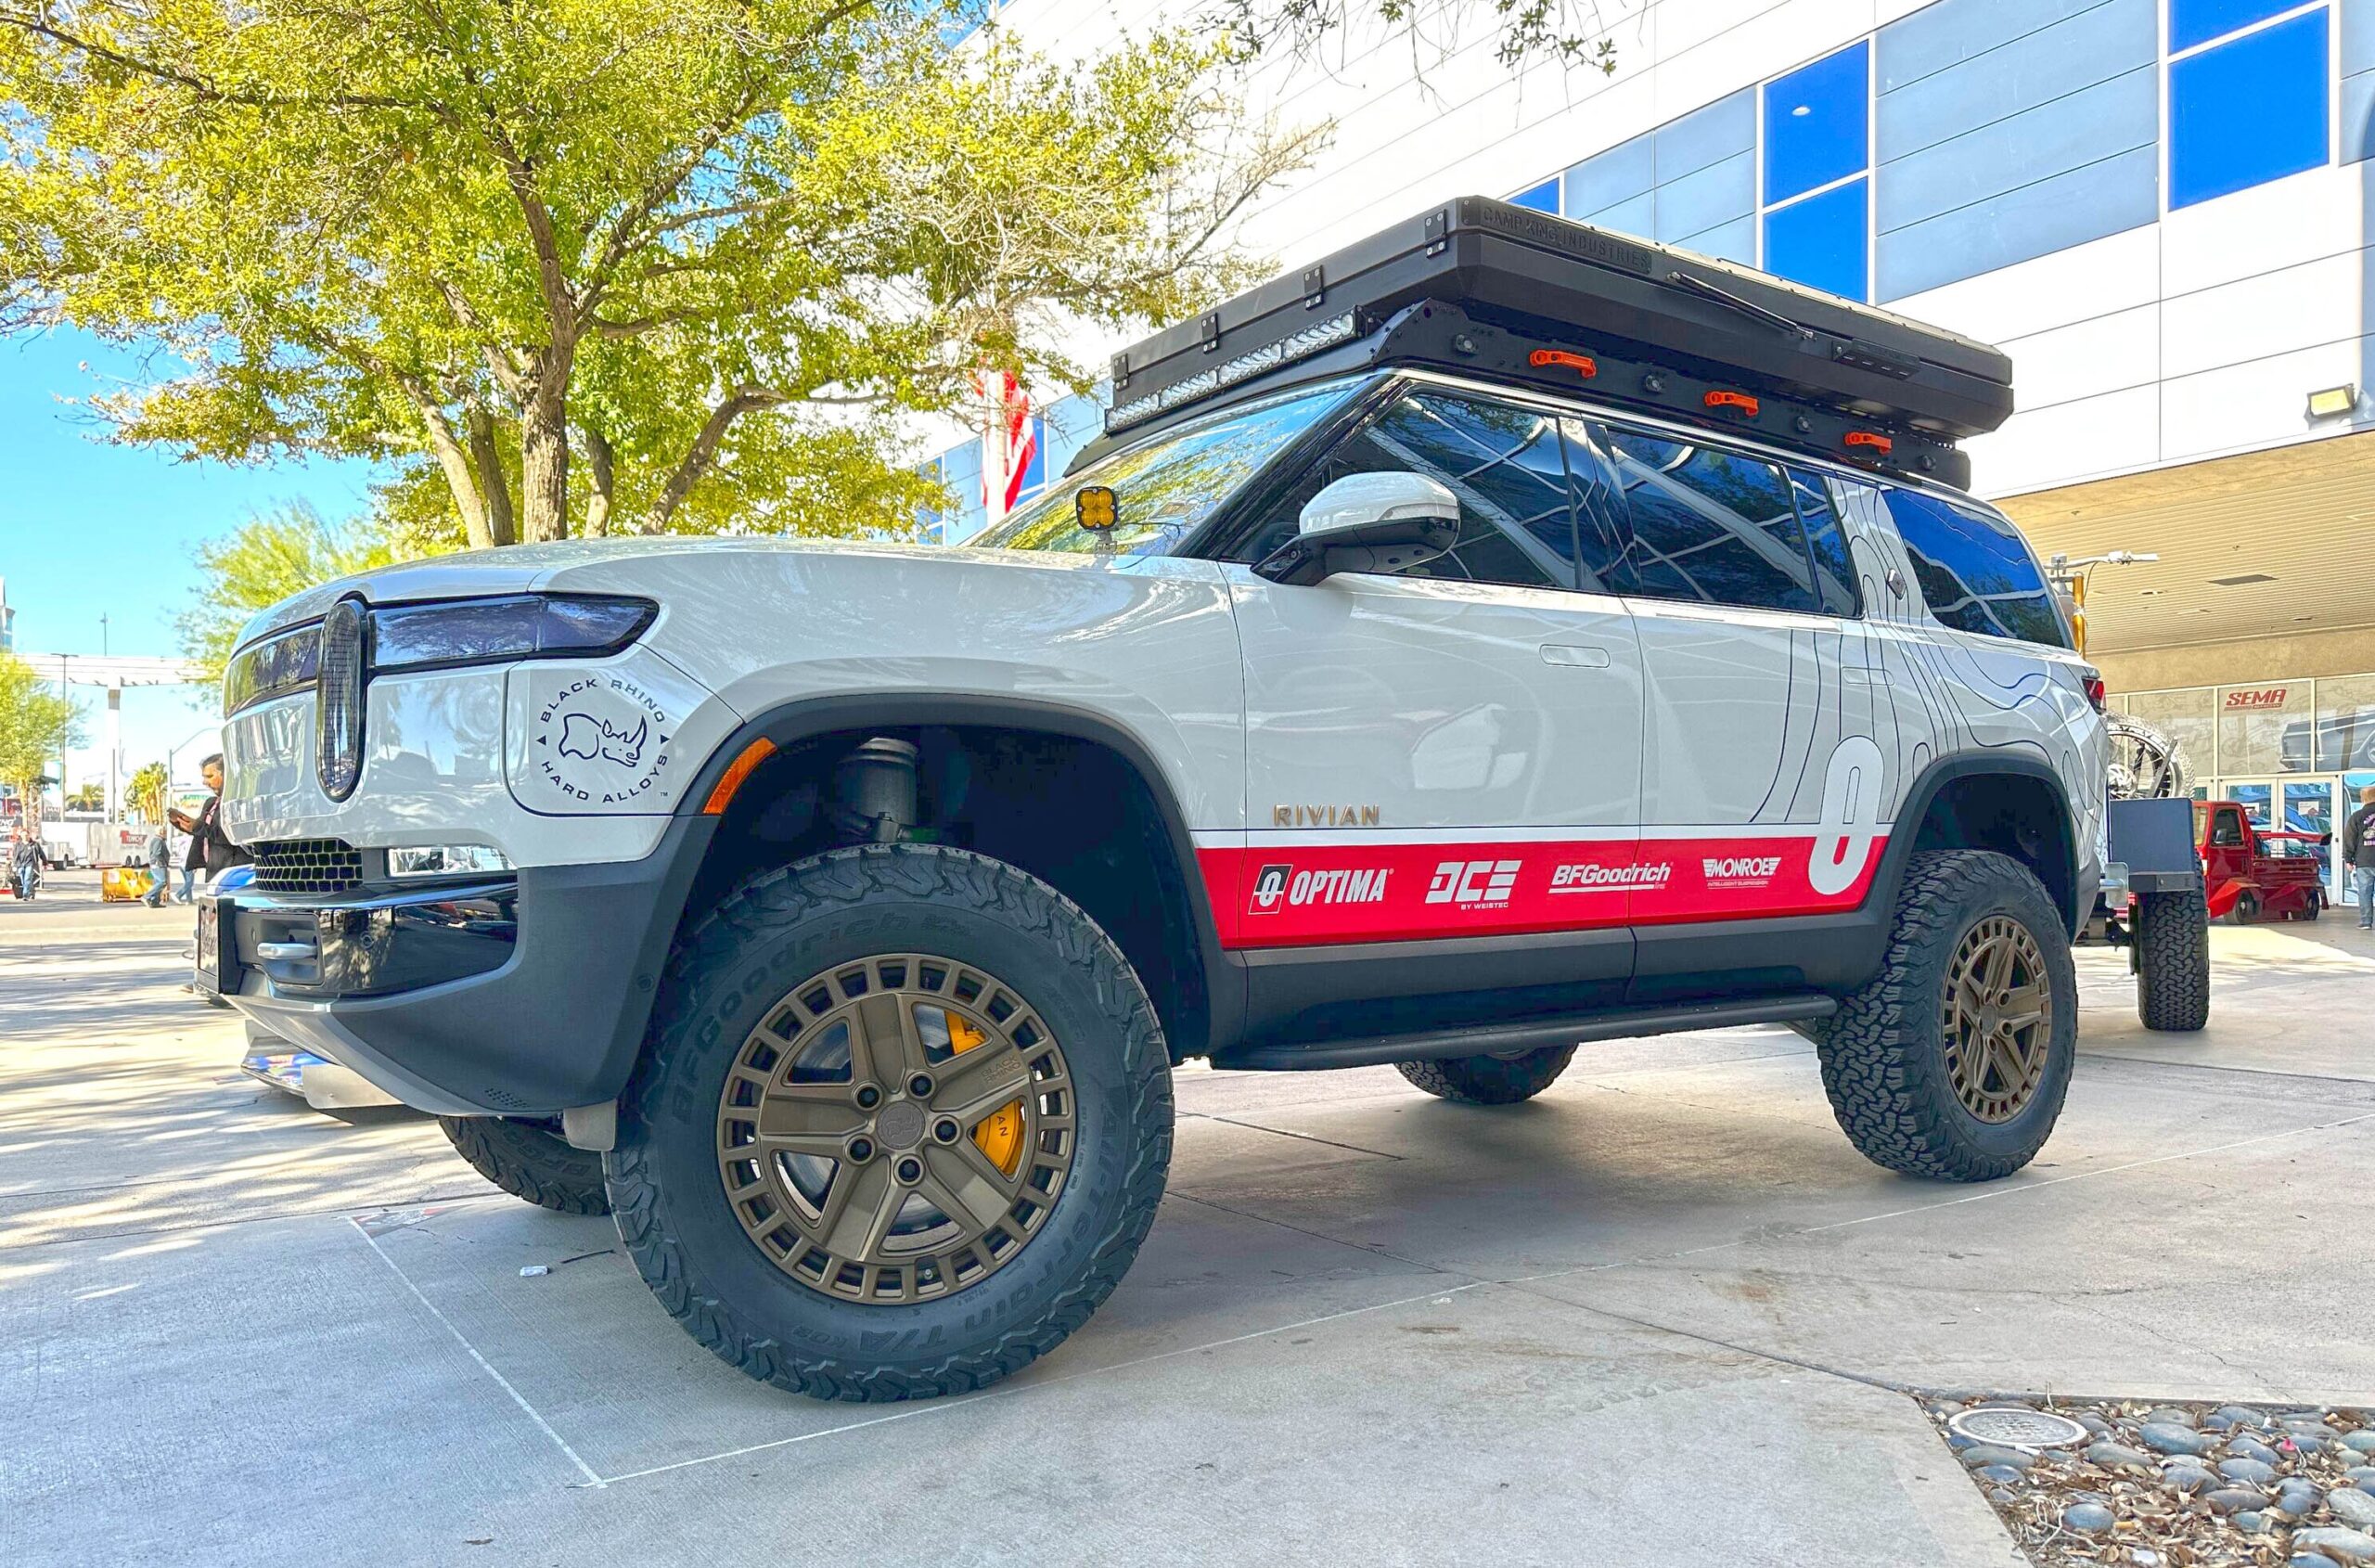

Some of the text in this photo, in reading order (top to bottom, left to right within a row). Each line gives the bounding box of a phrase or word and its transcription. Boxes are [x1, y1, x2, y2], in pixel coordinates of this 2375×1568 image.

[1484, 207, 1648, 268] CAMP KING INDUSTRIES
[540, 678, 665, 724] BLACK RHINO
[2226, 688, 2287, 706] SEMA
[542, 754, 668, 803] HARD ALLOYS
[1273, 803, 1380, 827] RIVIAN
[1550, 862, 1672, 886] BFGoodrich
[1709, 857, 1771, 878] MONROE
[1289, 868, 1389, 905] OPTIMA
[1473, 901, 1509, 910] WEISTEC
